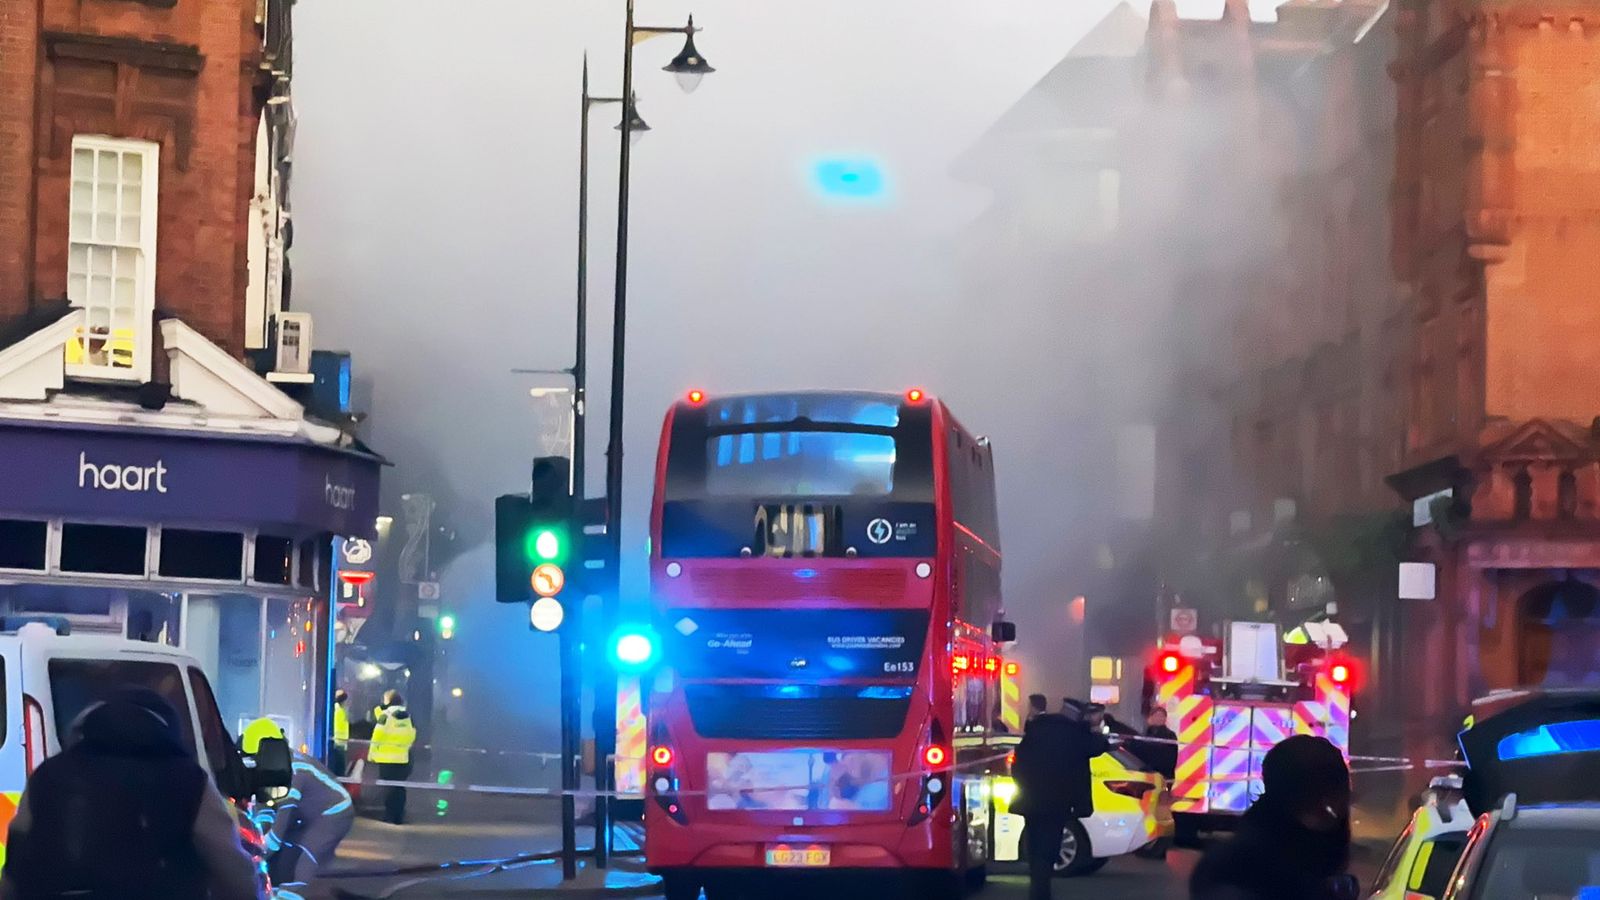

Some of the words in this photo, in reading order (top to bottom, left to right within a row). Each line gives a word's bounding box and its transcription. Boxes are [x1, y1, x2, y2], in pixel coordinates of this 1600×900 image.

[79, 451, 167, 493] haart
[325, 471, 356, 511] haart
[884, 661, 915, 672] Ee153
